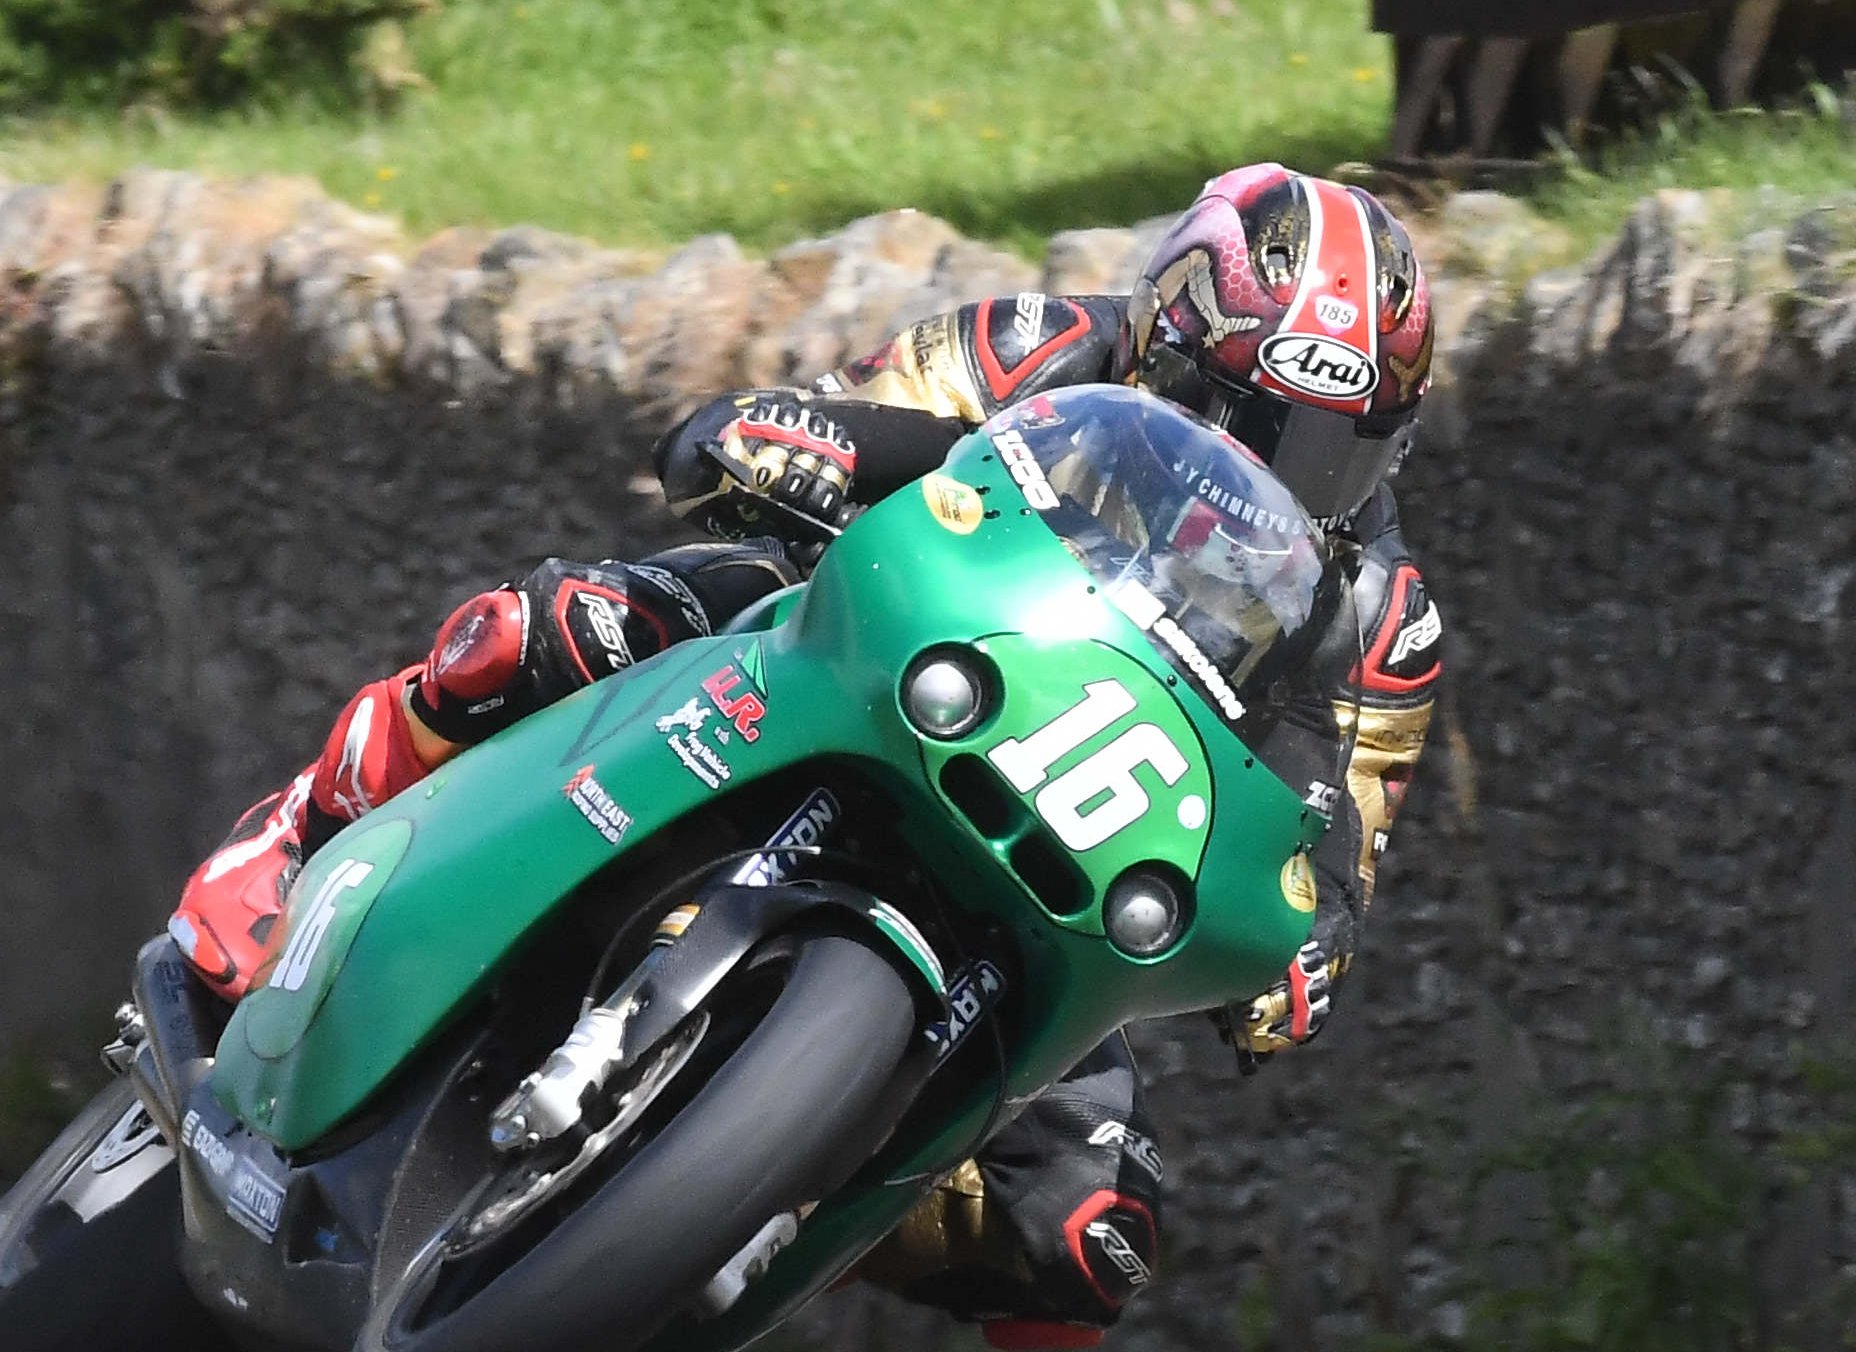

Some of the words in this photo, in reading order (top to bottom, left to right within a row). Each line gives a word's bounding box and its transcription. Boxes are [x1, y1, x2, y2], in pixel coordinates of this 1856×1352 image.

[1319, 303, 1352, 326] 185
[1270, 342, 1366, 387] Arai
[1296, 375, 1340, 392] HELMET
[1387, 599, 1443, 666] RS
[986, 678, 1192, 852] 16
[600, 799, 632, 832] EAST
[268, 857, 376, 992] 16
